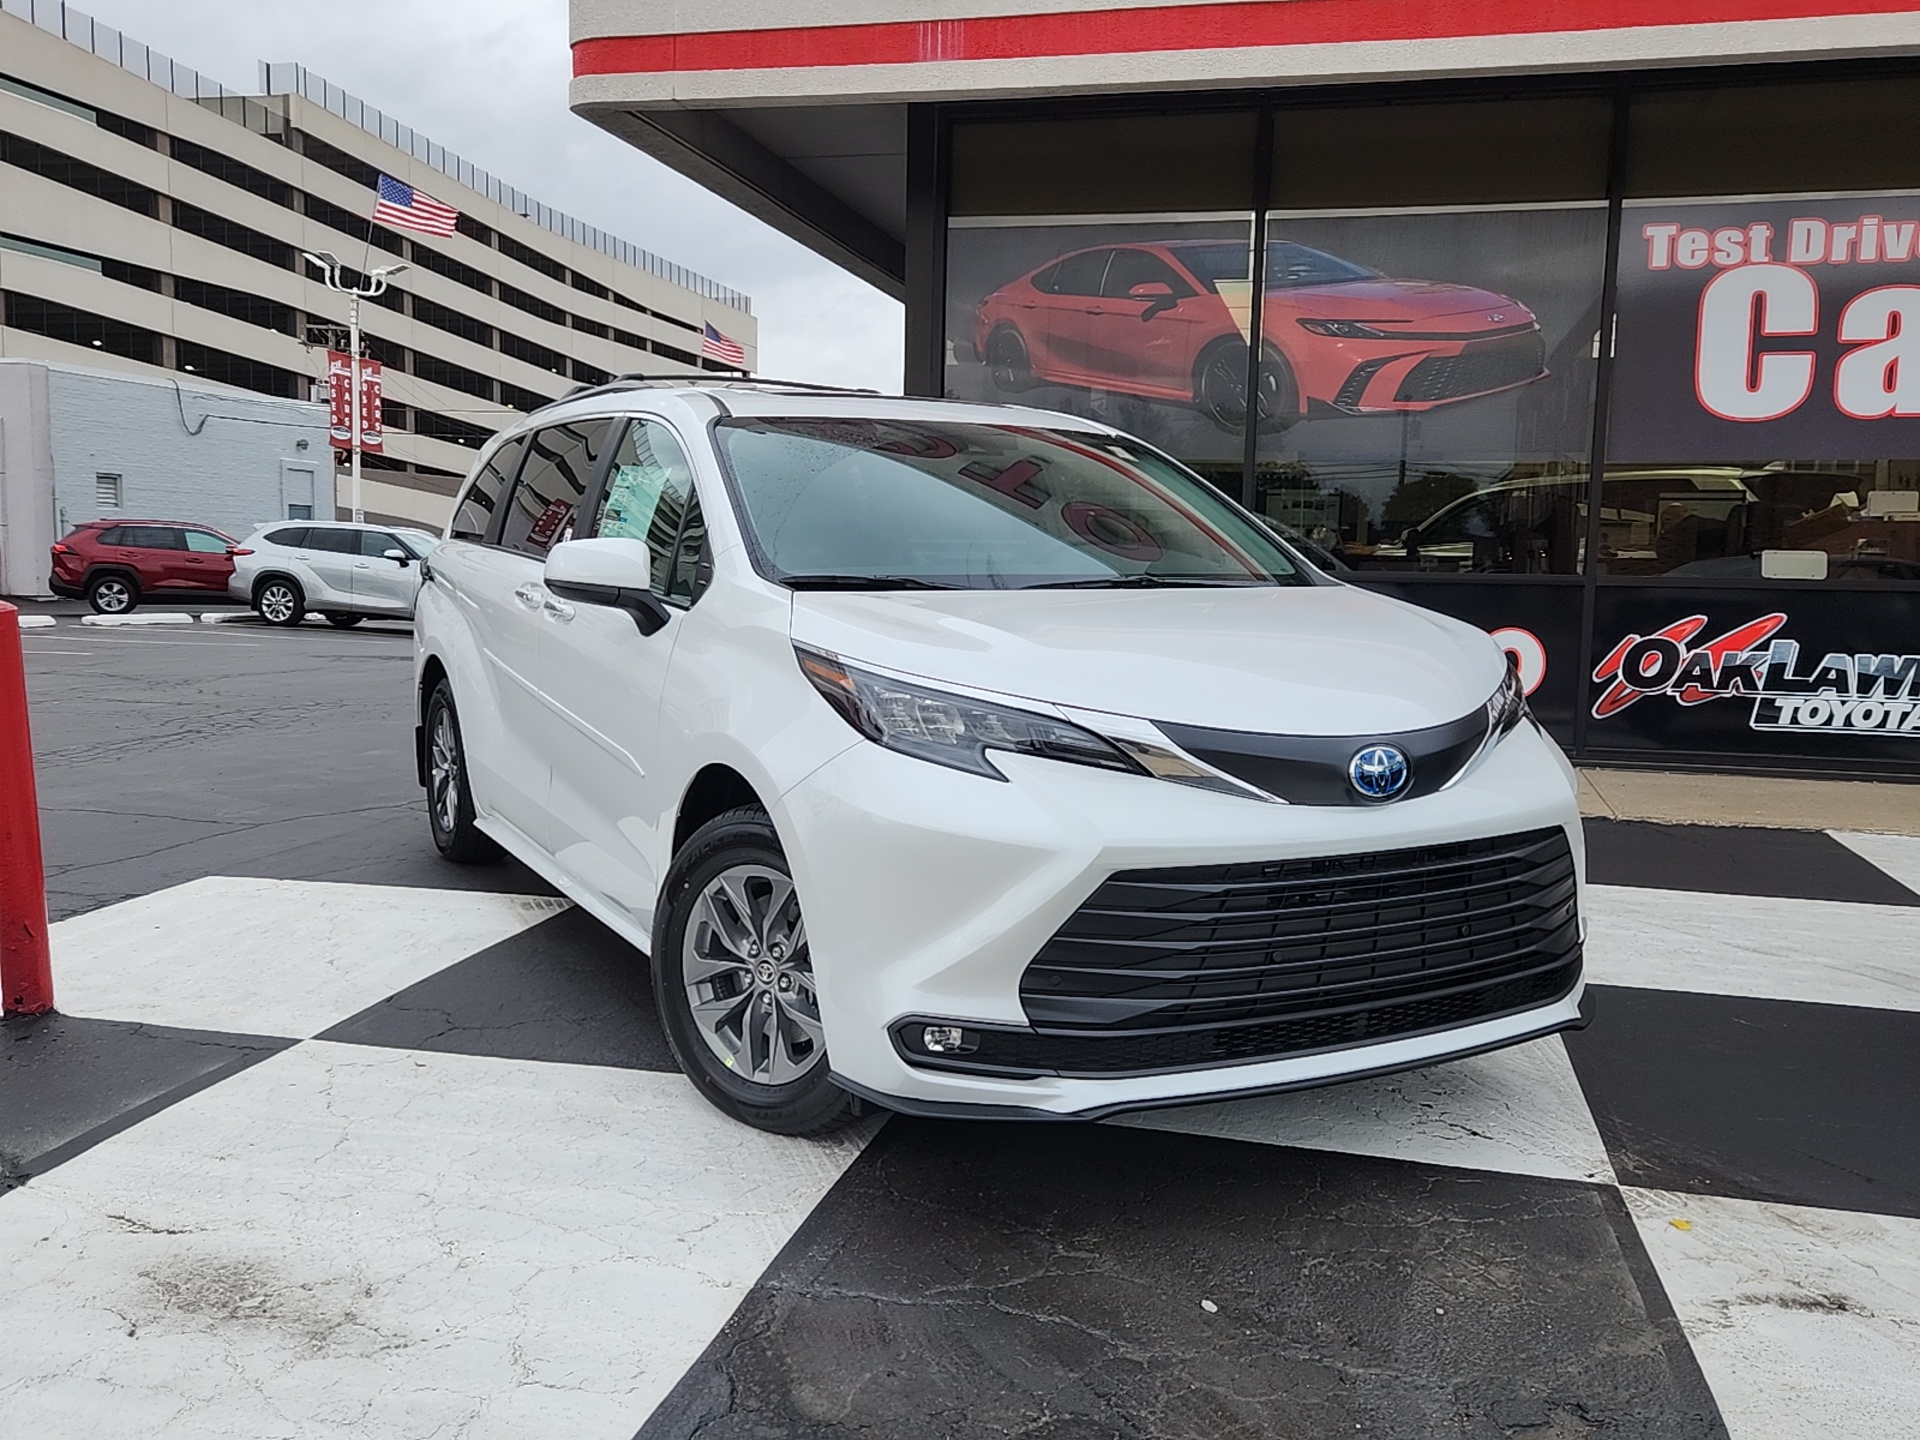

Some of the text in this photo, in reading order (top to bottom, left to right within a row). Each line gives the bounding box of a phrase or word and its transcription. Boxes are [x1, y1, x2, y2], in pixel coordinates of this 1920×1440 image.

[1643, 215, 1920, 271] Test Driv
[330, 376, 338, 424] USED
